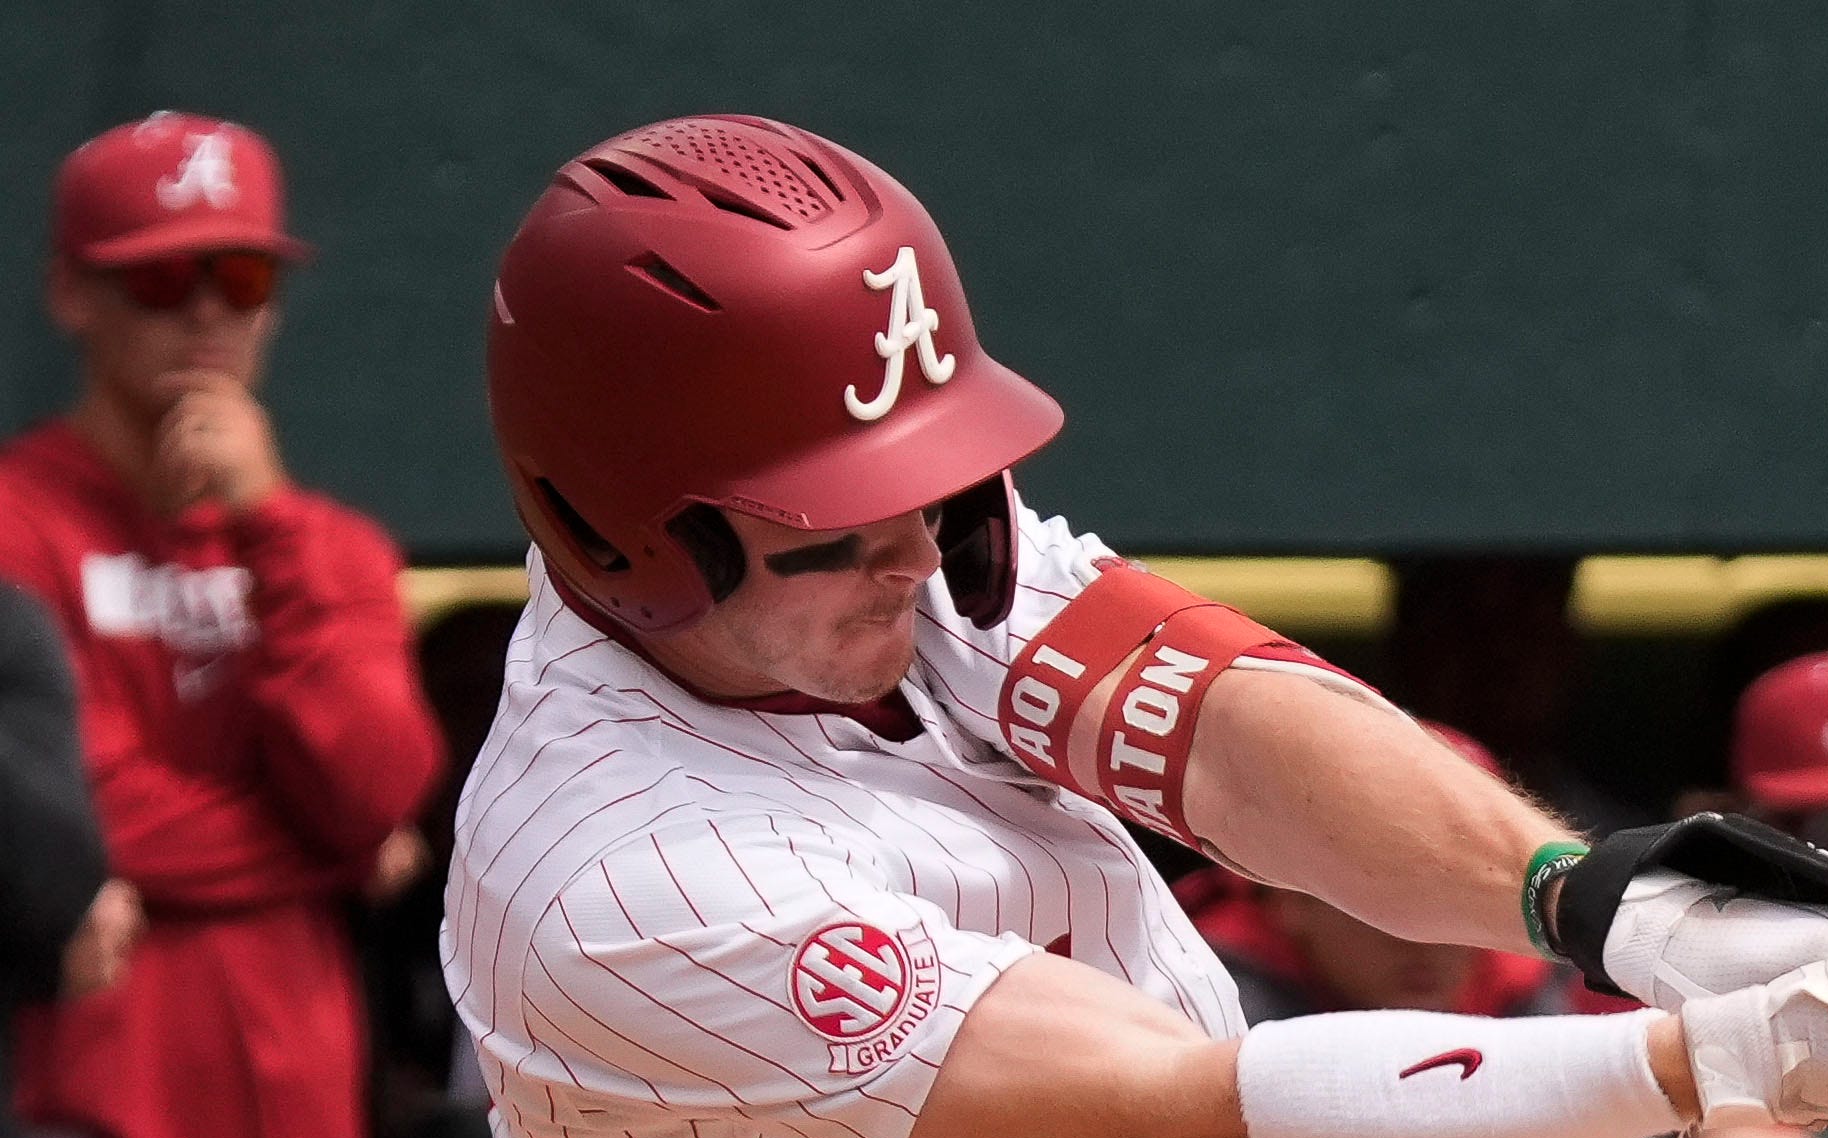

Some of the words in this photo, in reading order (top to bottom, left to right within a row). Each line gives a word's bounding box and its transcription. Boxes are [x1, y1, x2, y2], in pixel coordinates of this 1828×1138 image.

[844, 246, 956, 421] A
[796, 926, 902, 1034] SEC
[857, 954, 936, 1067] GRADUATE
